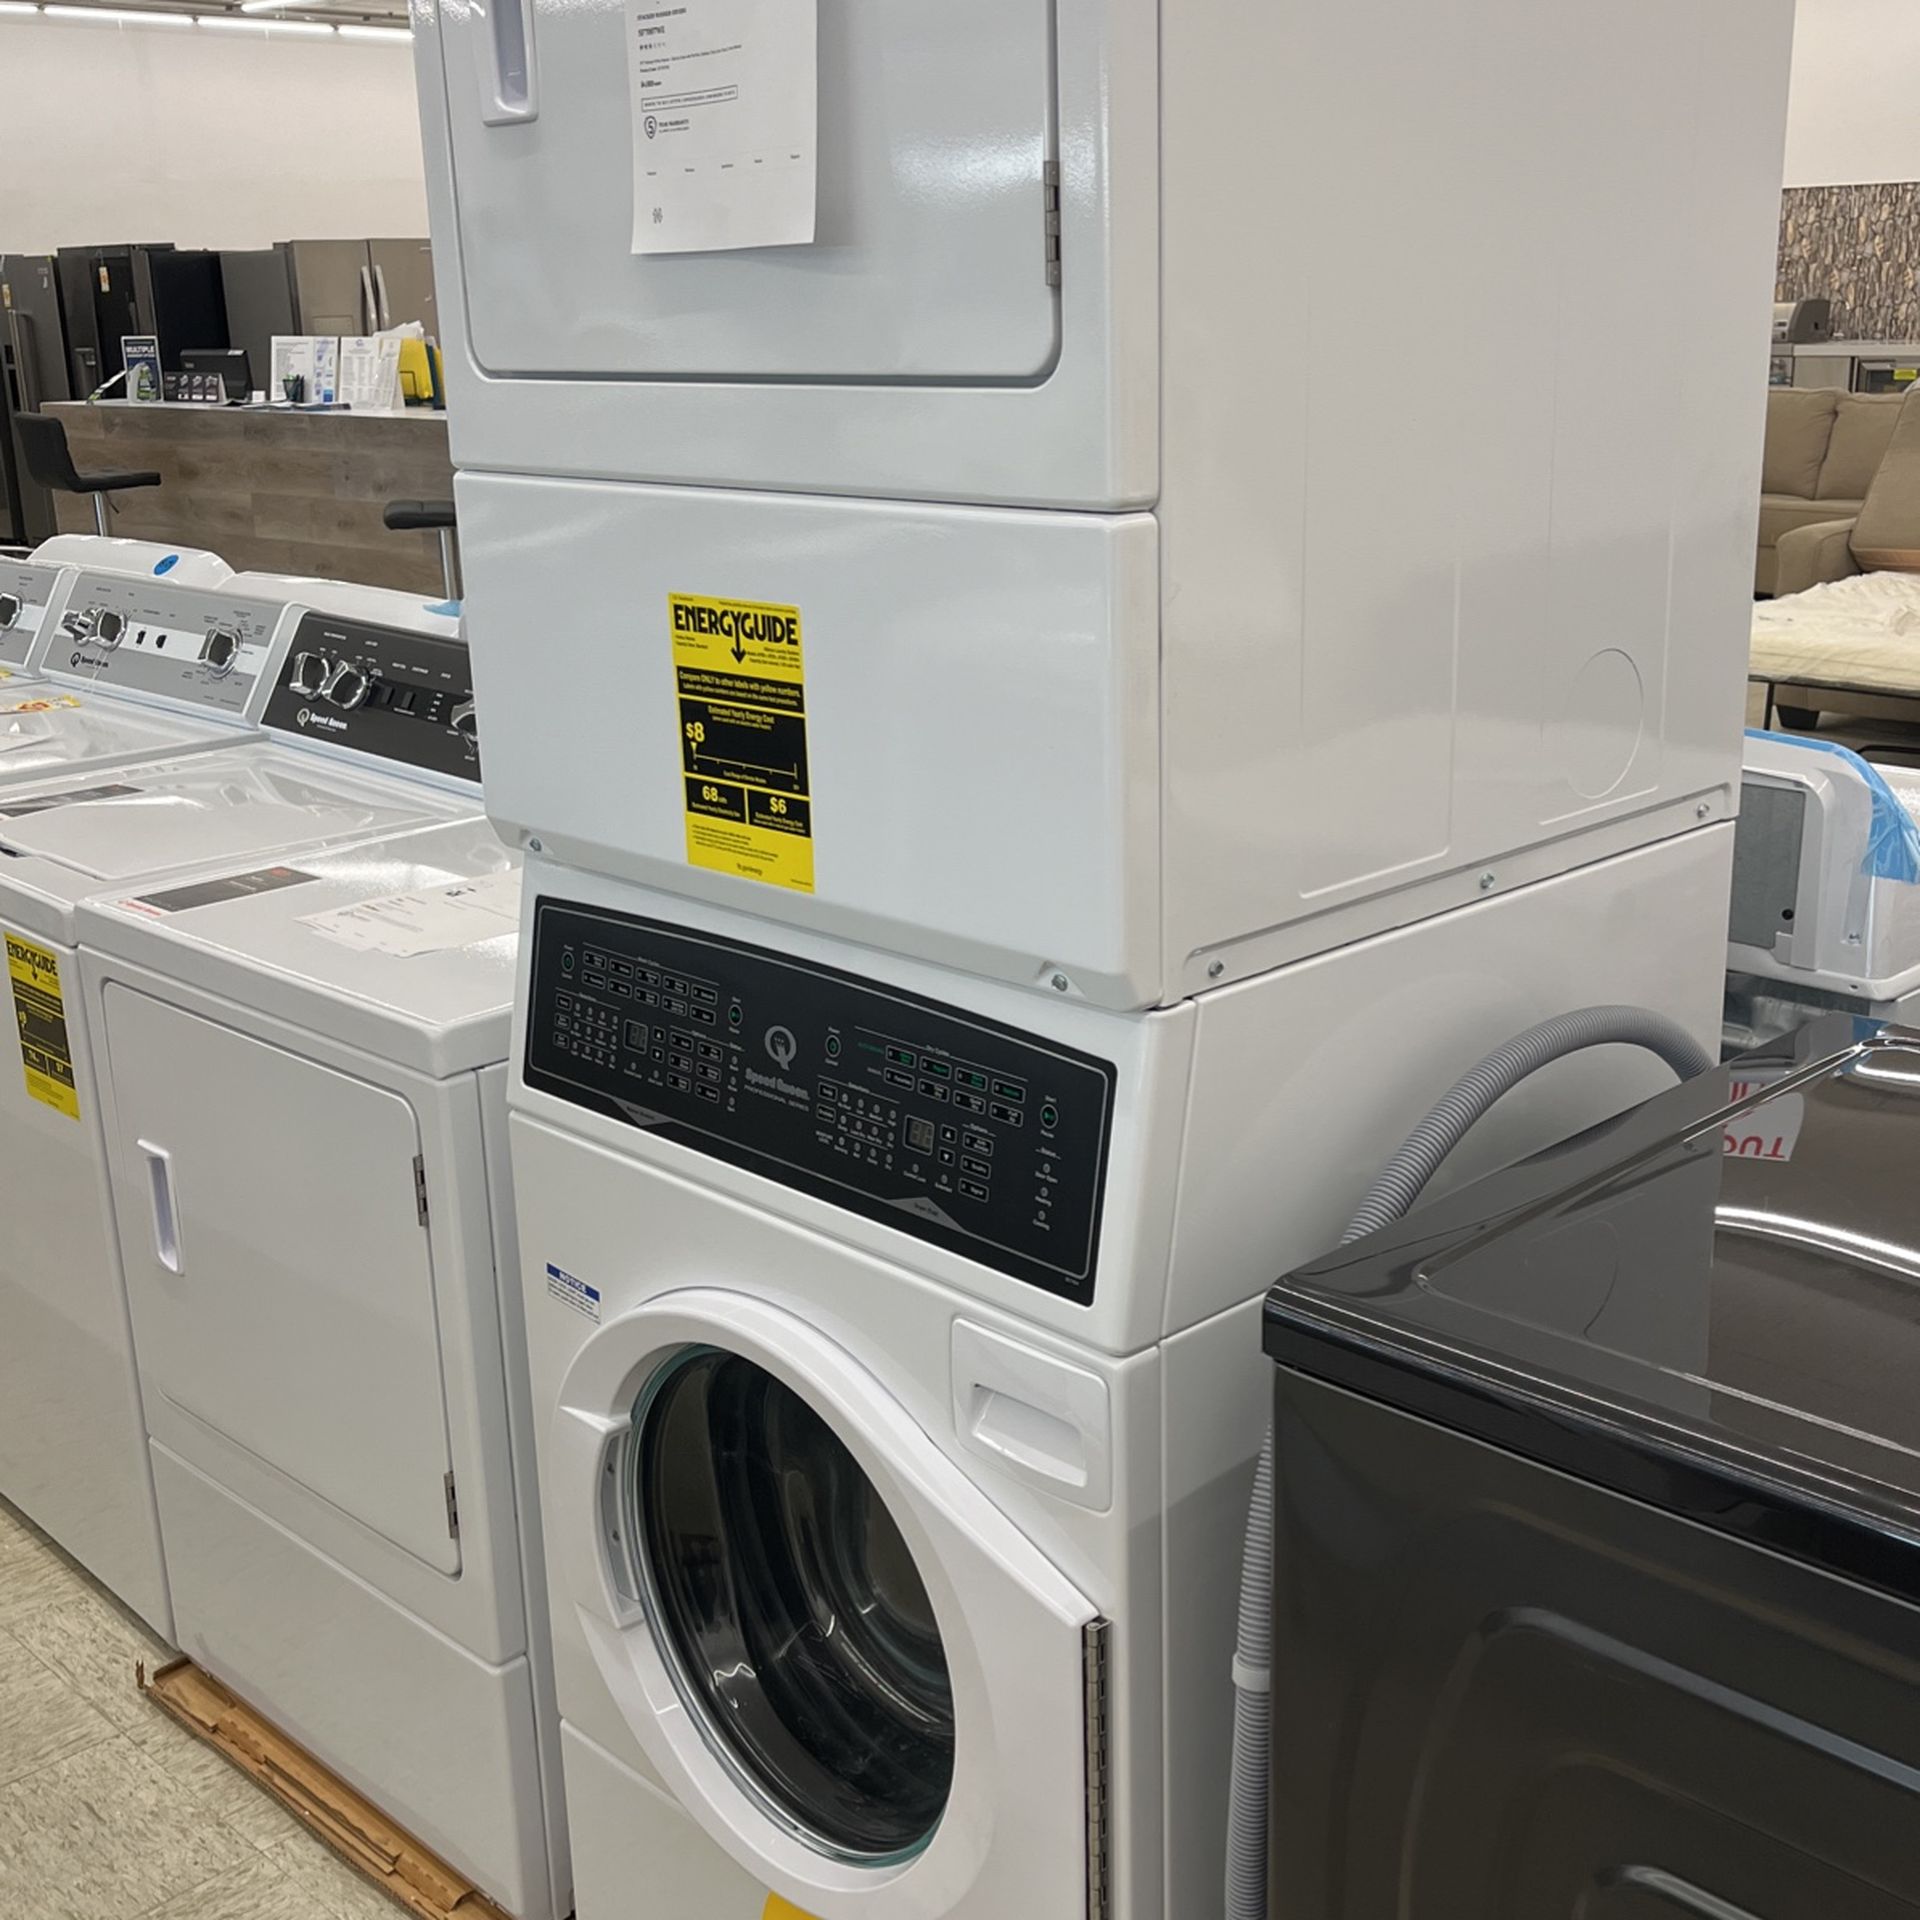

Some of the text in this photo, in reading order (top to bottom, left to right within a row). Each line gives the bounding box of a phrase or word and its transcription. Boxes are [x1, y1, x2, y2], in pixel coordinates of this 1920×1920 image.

[673, 604, 798, 646] ENERGYGUIDE
[310, 712, 328, 725] Speed
[328, 717, 348, 731] Queen
[685, 721, 705, 742] $8
[702, 785, 718, 802] 68
[770, 797, 787, 814] $6
[745, 1067, 810, 1100] Speed Queen
